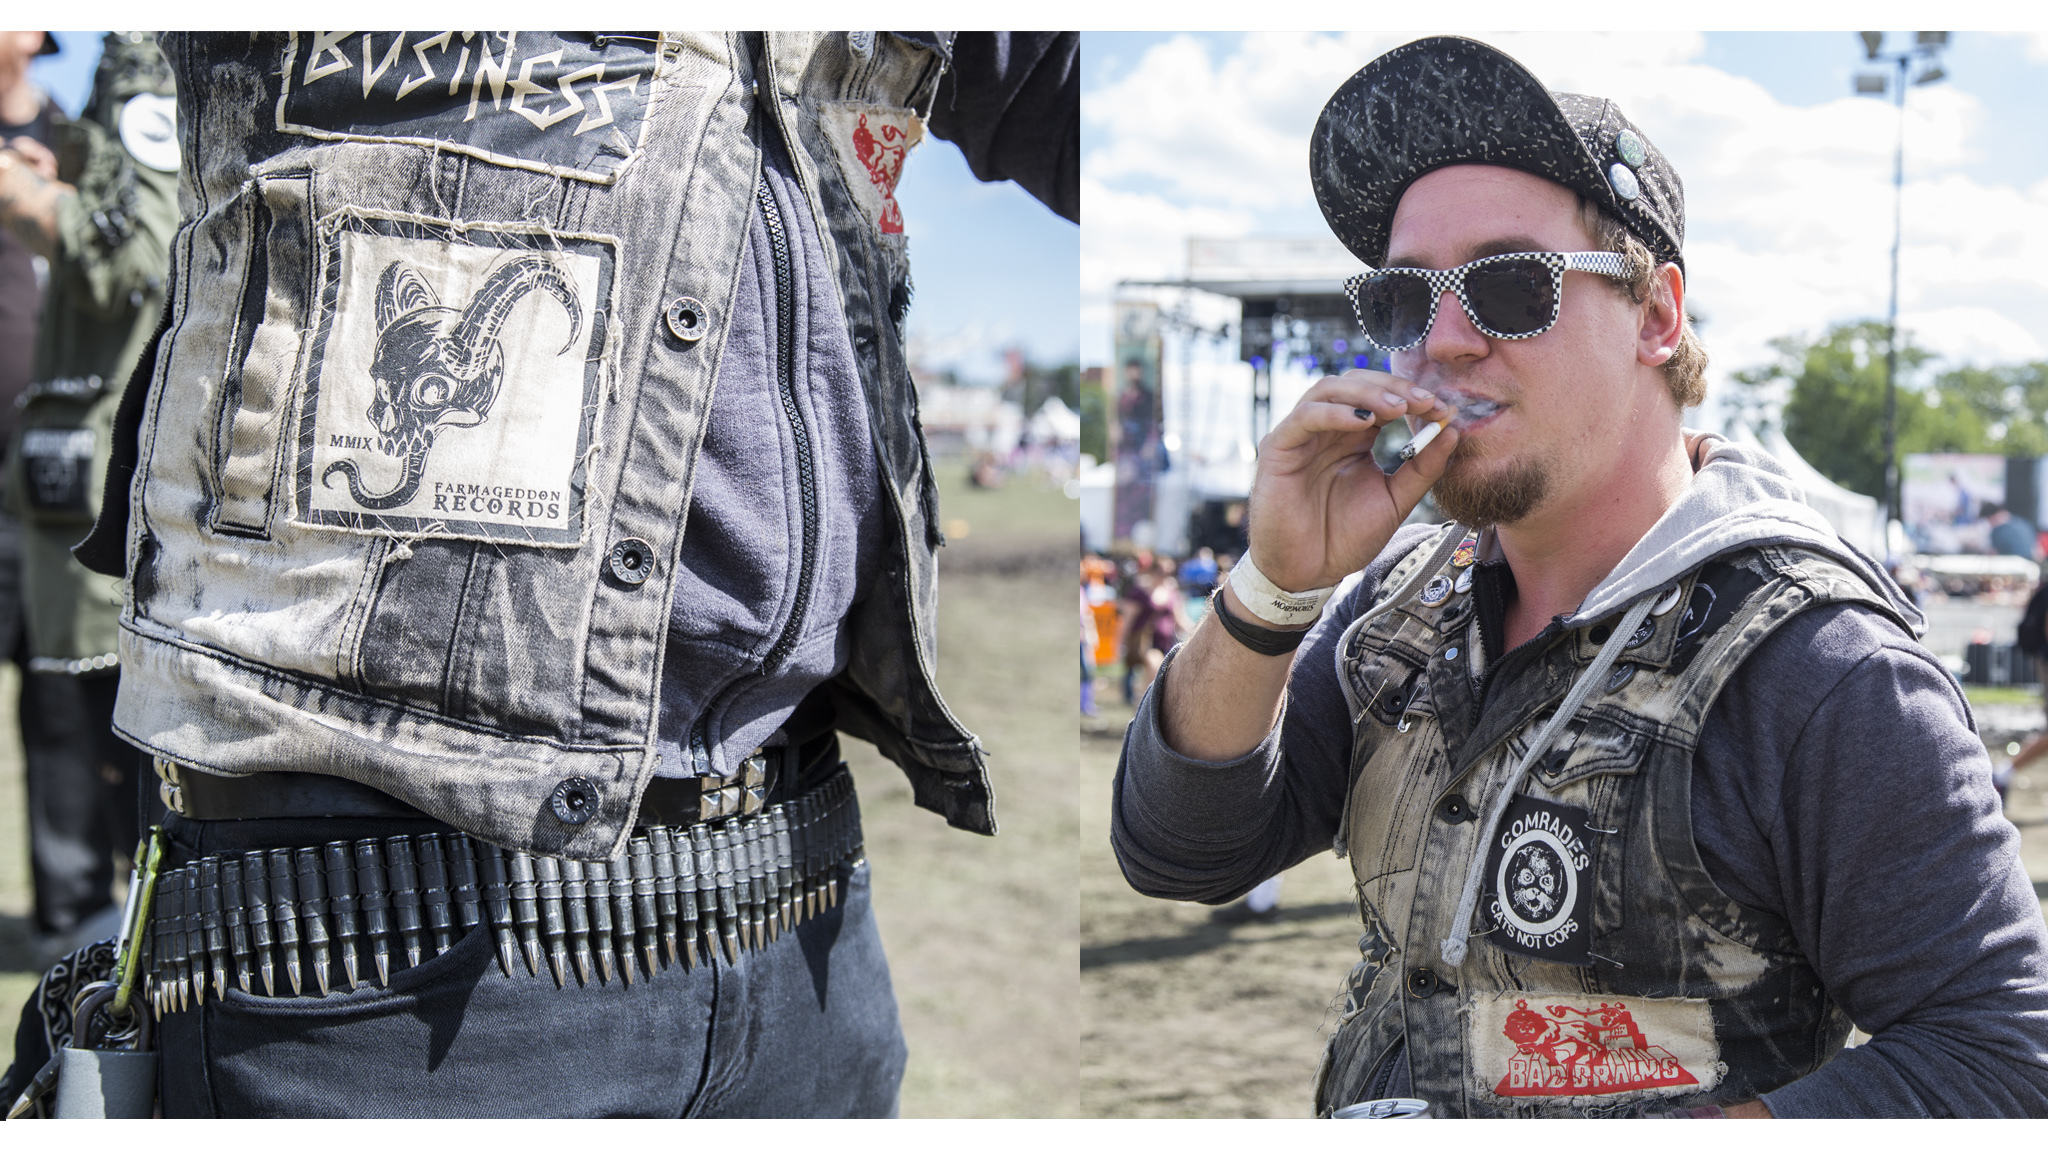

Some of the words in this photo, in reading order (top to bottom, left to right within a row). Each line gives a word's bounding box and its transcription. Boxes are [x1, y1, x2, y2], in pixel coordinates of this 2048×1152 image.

[330, 434, 373, 452] MMIX
[434, 482, 561, 501] FARMAGEDDON
[432, 494, 561, 520] RECORDS
[1271, 600, 1314, 612] STRONGBOW
[1501, 811, 1590, 872] COMRADES
[1490, 900, 1515, 938] CATS
[1516, 932, 1542, 949] NOT
[1545, 918, 1579, 948] COPS
[1509, 1059, 1568, 1088] BAD
